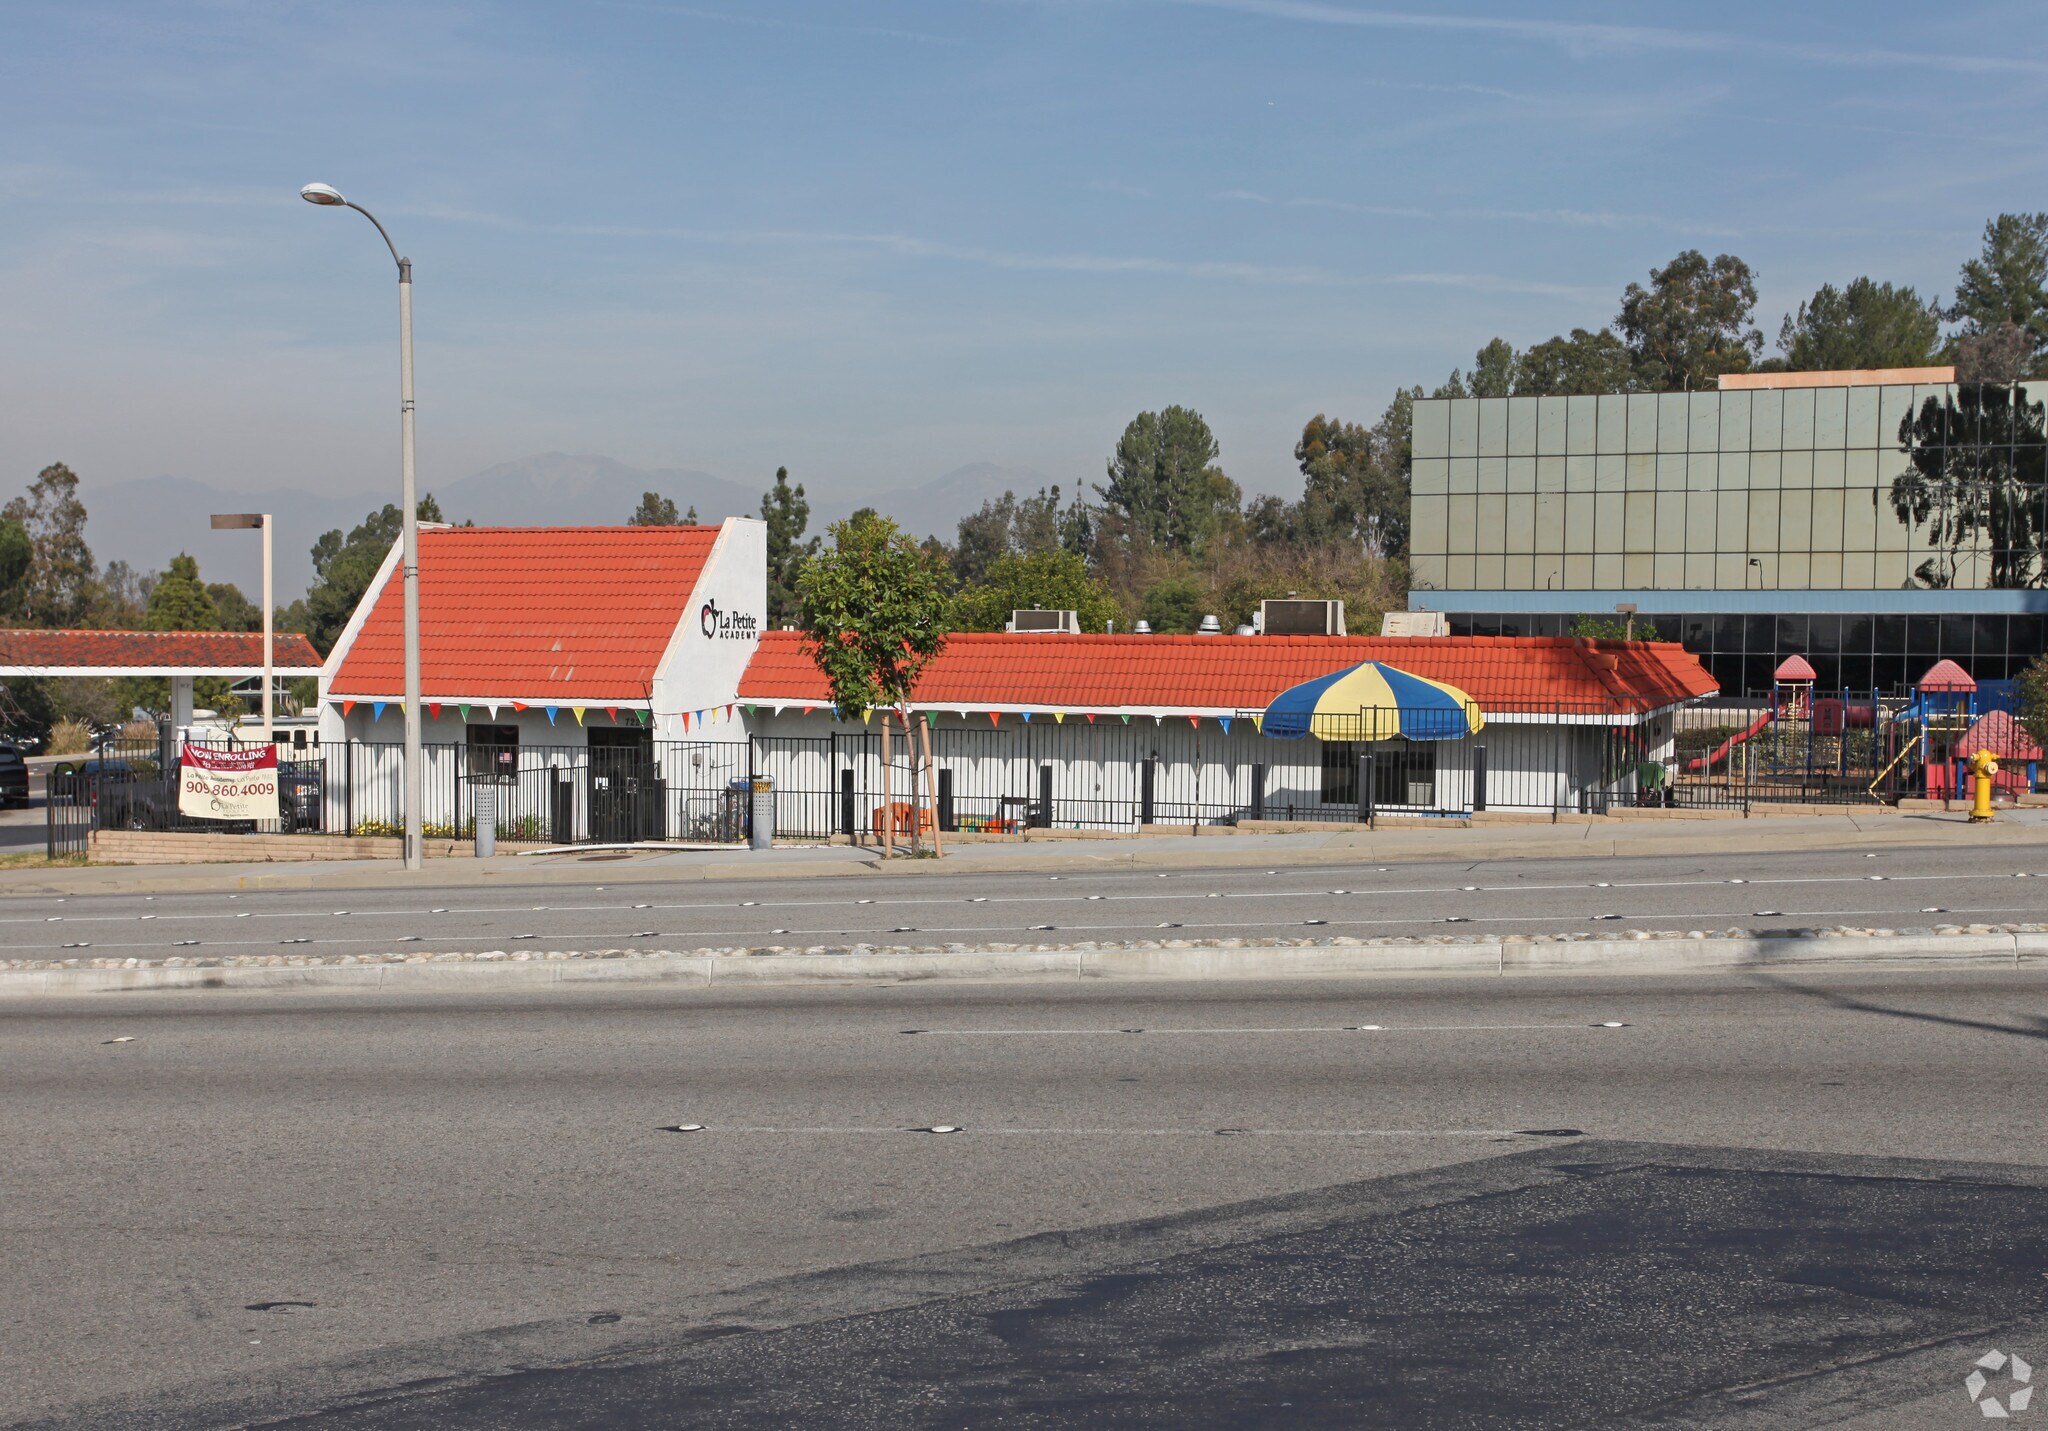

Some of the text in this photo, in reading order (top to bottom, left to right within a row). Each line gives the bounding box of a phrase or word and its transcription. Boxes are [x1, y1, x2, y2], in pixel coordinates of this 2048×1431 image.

[719, 610, 756, 629] La Petite
[719, 630, 757, 640] ACADEMY
[191, 748, 266, 760] NOW ENROLLING
[186, 781, 274, 796] 909.860.4009
